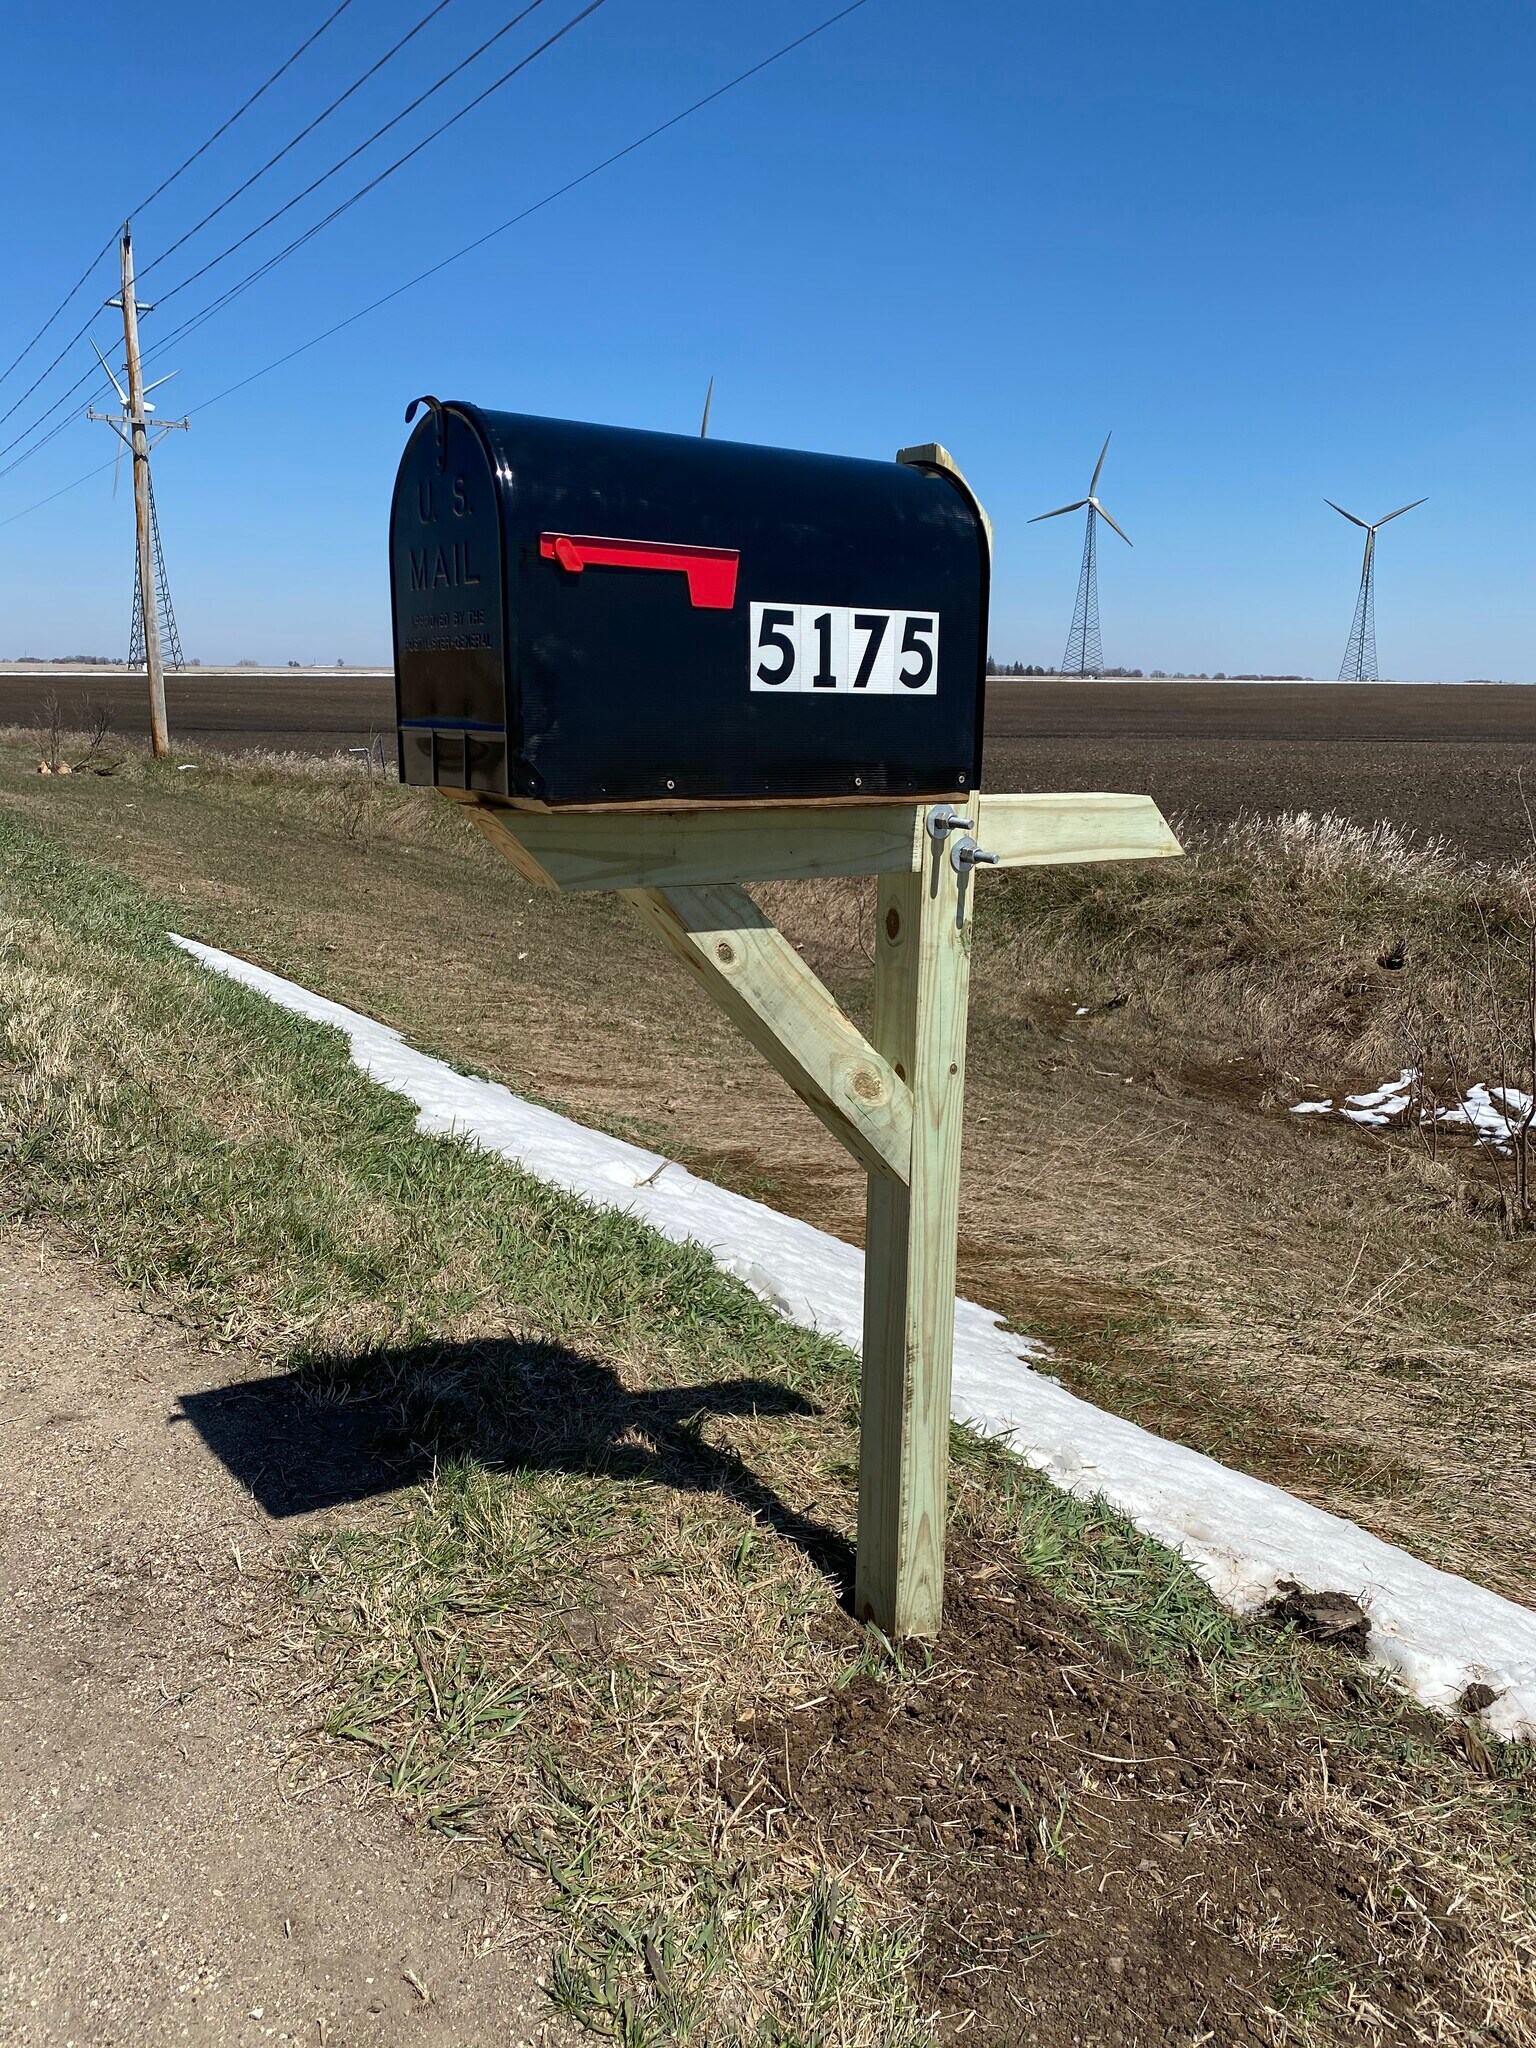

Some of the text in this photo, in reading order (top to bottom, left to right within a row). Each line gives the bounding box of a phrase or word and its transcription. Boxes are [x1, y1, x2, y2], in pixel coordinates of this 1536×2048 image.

[410, 541, 480, 591] MAIL
[453, 611, 465, 628] BY
[467, 608, 486, 626] THE
[756, 608, 934, 689] 5175
